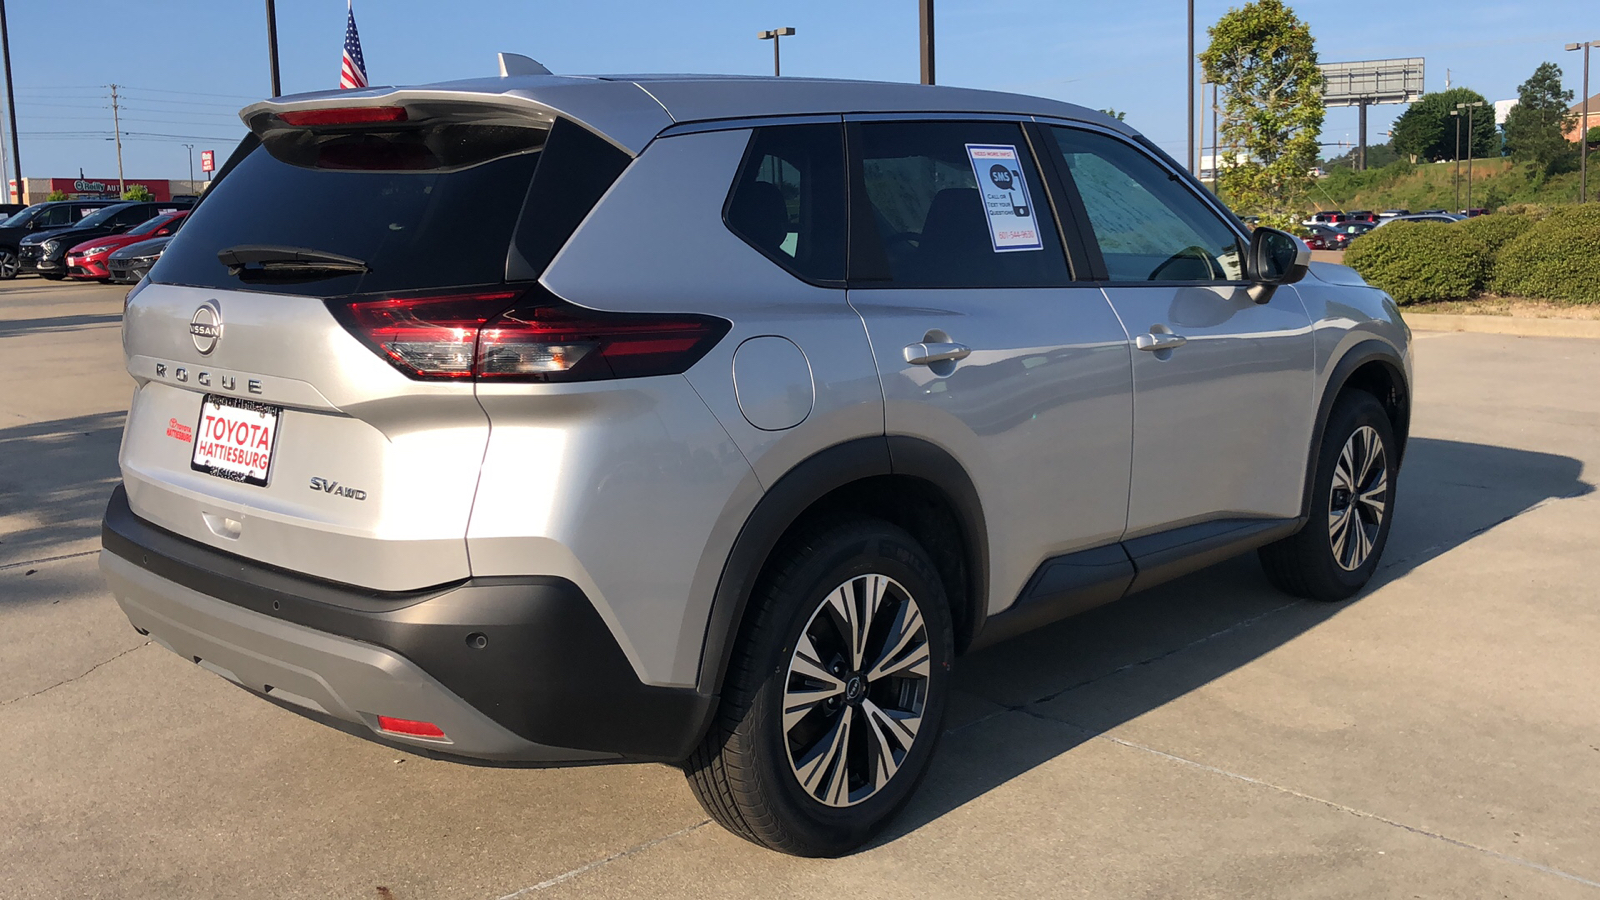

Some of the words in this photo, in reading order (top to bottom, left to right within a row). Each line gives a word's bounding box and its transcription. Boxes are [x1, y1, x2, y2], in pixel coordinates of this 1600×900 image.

[992, 172, 1010, 182] SMS
[74, 180, 105, 192] O'Reilly
[189, 324, 220, 337] NISSAN
[156, 363, 263, 395] ROGUE
[166, 427, 192, 443] HATTIESBURG
[176, 423, 192, 433] TOYOTA
[205, 415, 270, 451] TOYOTA
[199, 440, 268, 470] HATTIESBURG
[309, 476, 337, 496] SV
[335, 485, 367, 501] AWD
